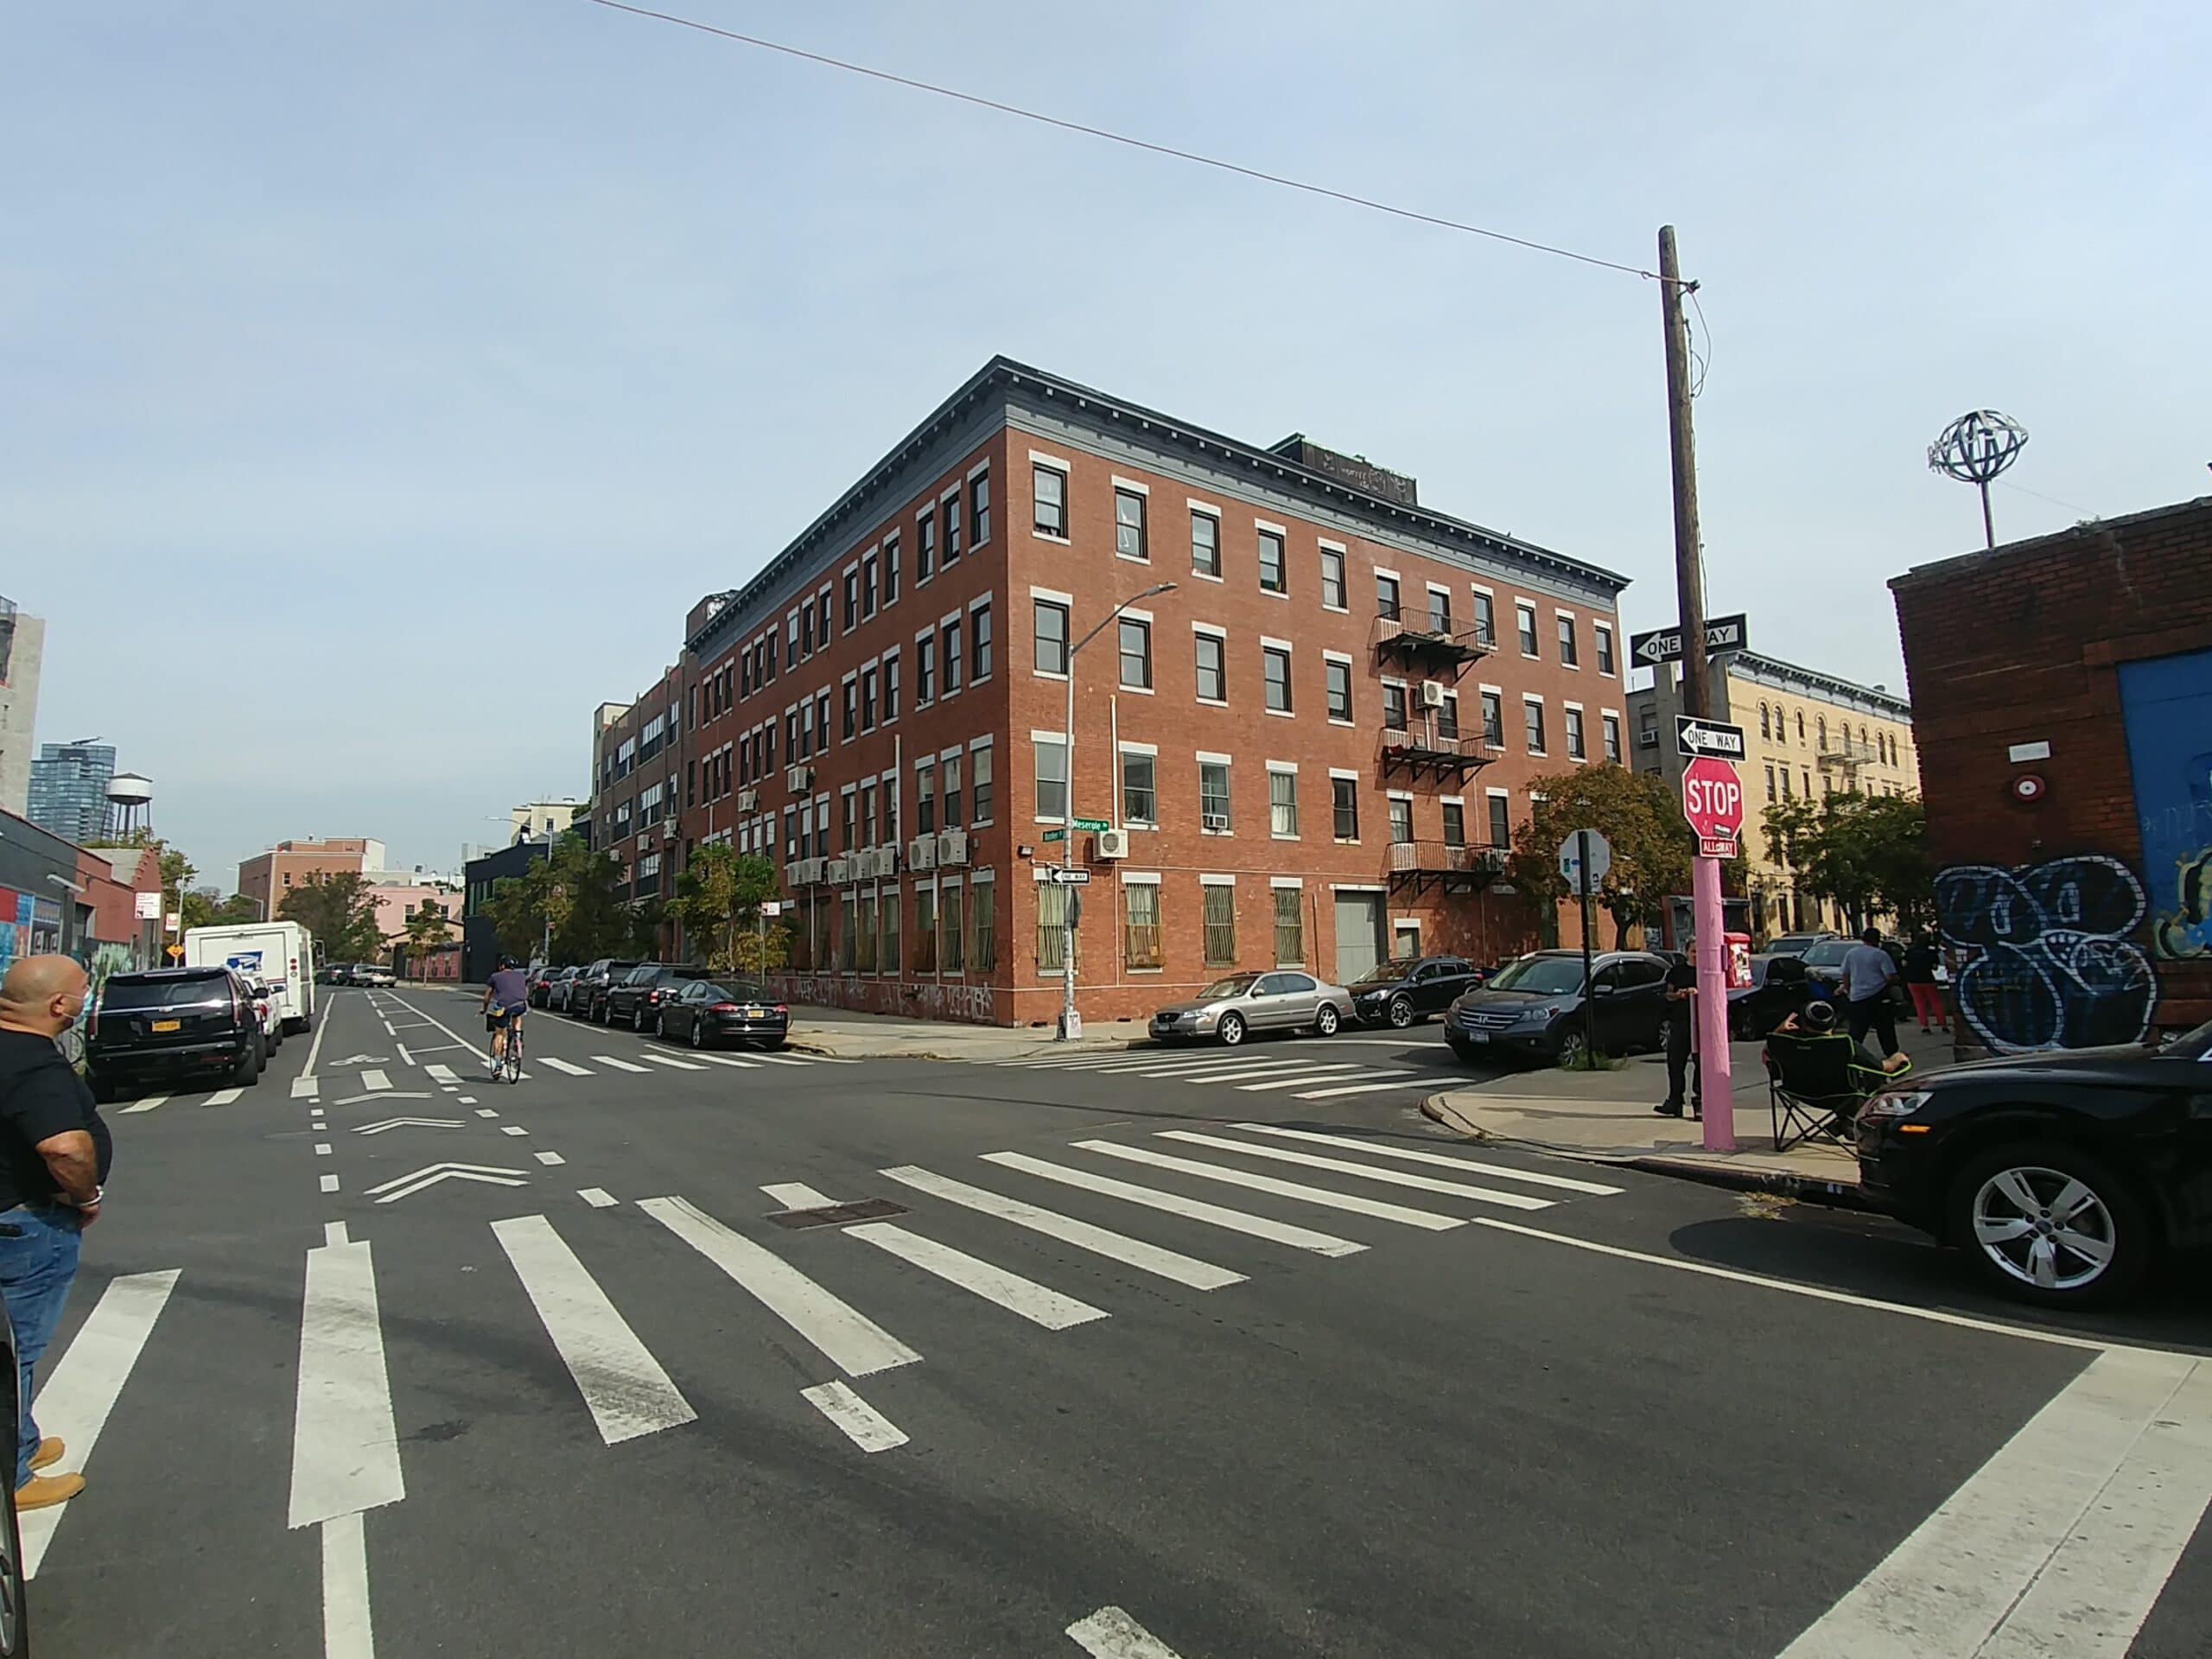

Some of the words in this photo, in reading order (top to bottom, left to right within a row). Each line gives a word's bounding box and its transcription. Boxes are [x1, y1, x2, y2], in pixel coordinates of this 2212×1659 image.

[1647, 637, 1679, 655] ONE
[1704, 627, 1731, 644] AY
[1688, 729, 1708, 746] ONE
[1715, 734, 1737, 753] WAY
[1688, 779, 1739, 817] STOP
[1071, 819, 1102, 830] Meserole
